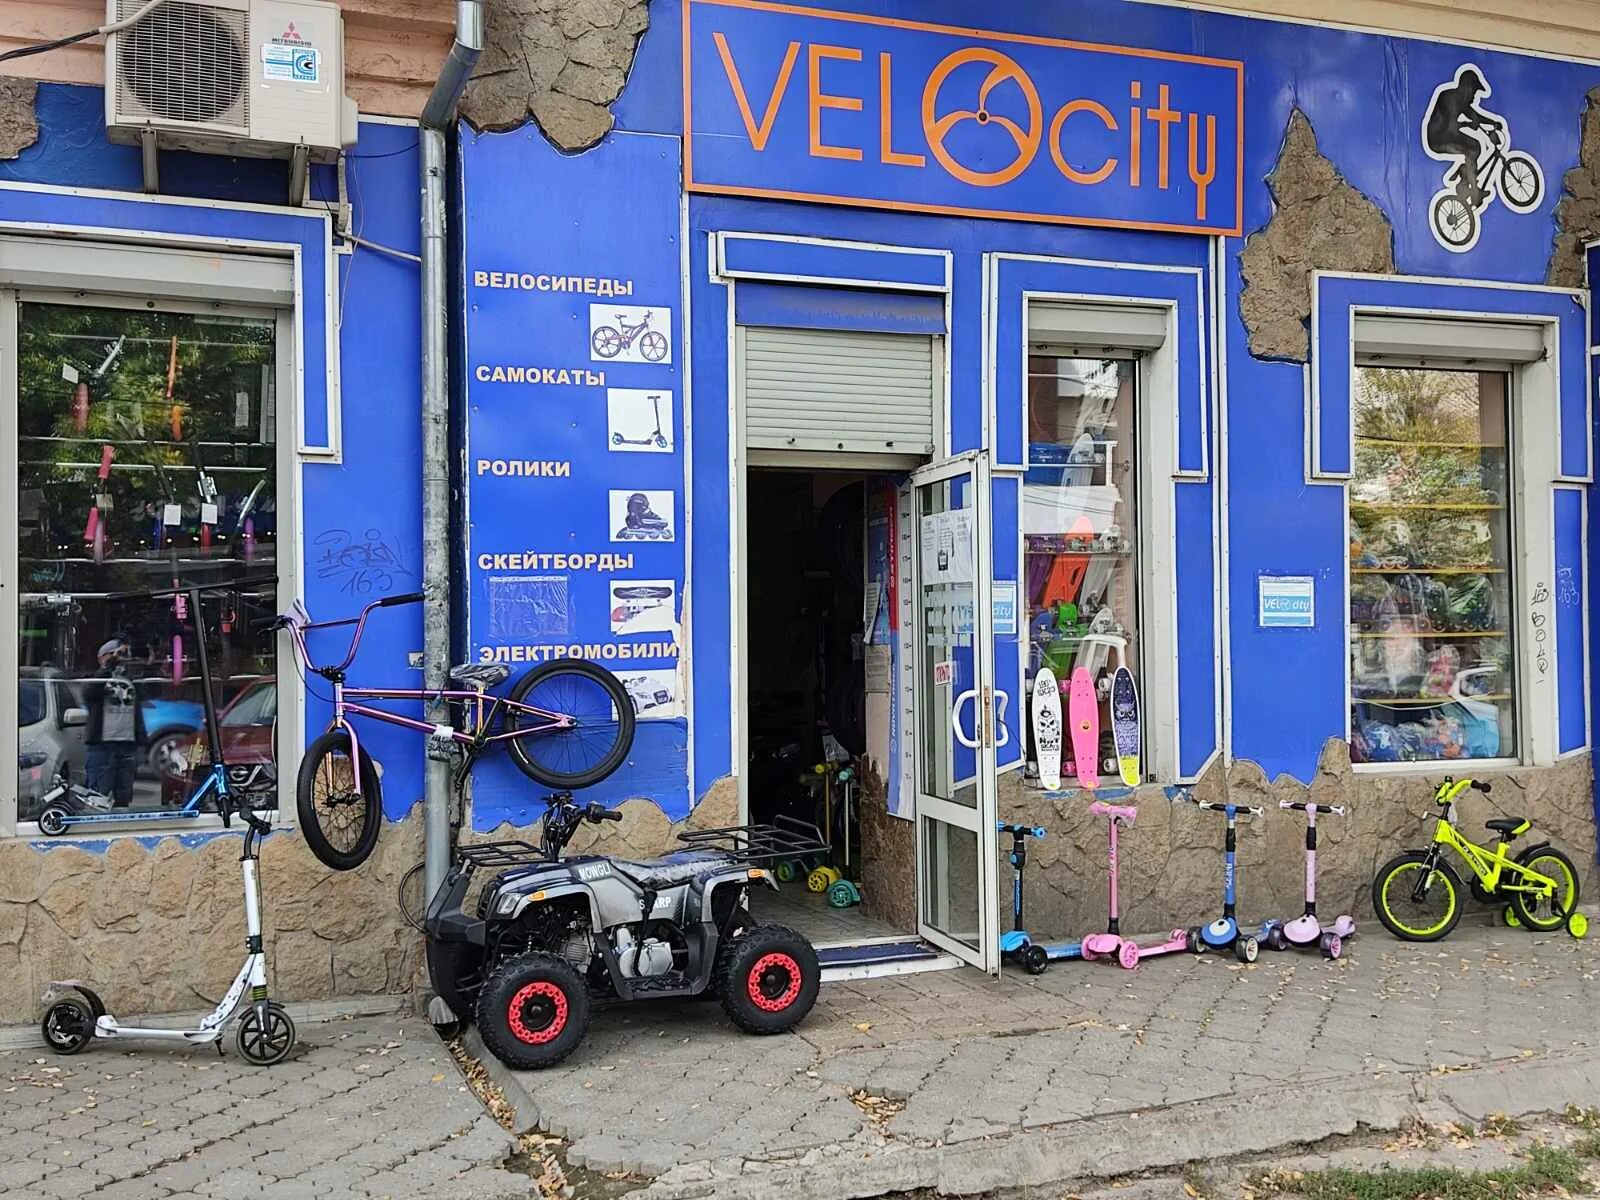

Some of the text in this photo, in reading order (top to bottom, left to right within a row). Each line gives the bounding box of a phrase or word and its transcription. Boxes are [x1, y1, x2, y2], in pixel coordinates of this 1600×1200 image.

[474, 271, 633, 298] ВЕЛОСИПЕДЫ
[476, 365, 605, 386] САМОКАТЫ
[477, 459, 570, 477] РОЛИКИ
[478, 550, 634, 572] СКЕЙТБОРДЫ
[479, 641, 678, 663] ЭЛЕКТРОМОБИЛИ
[639, 896, 672, 911] SARP
